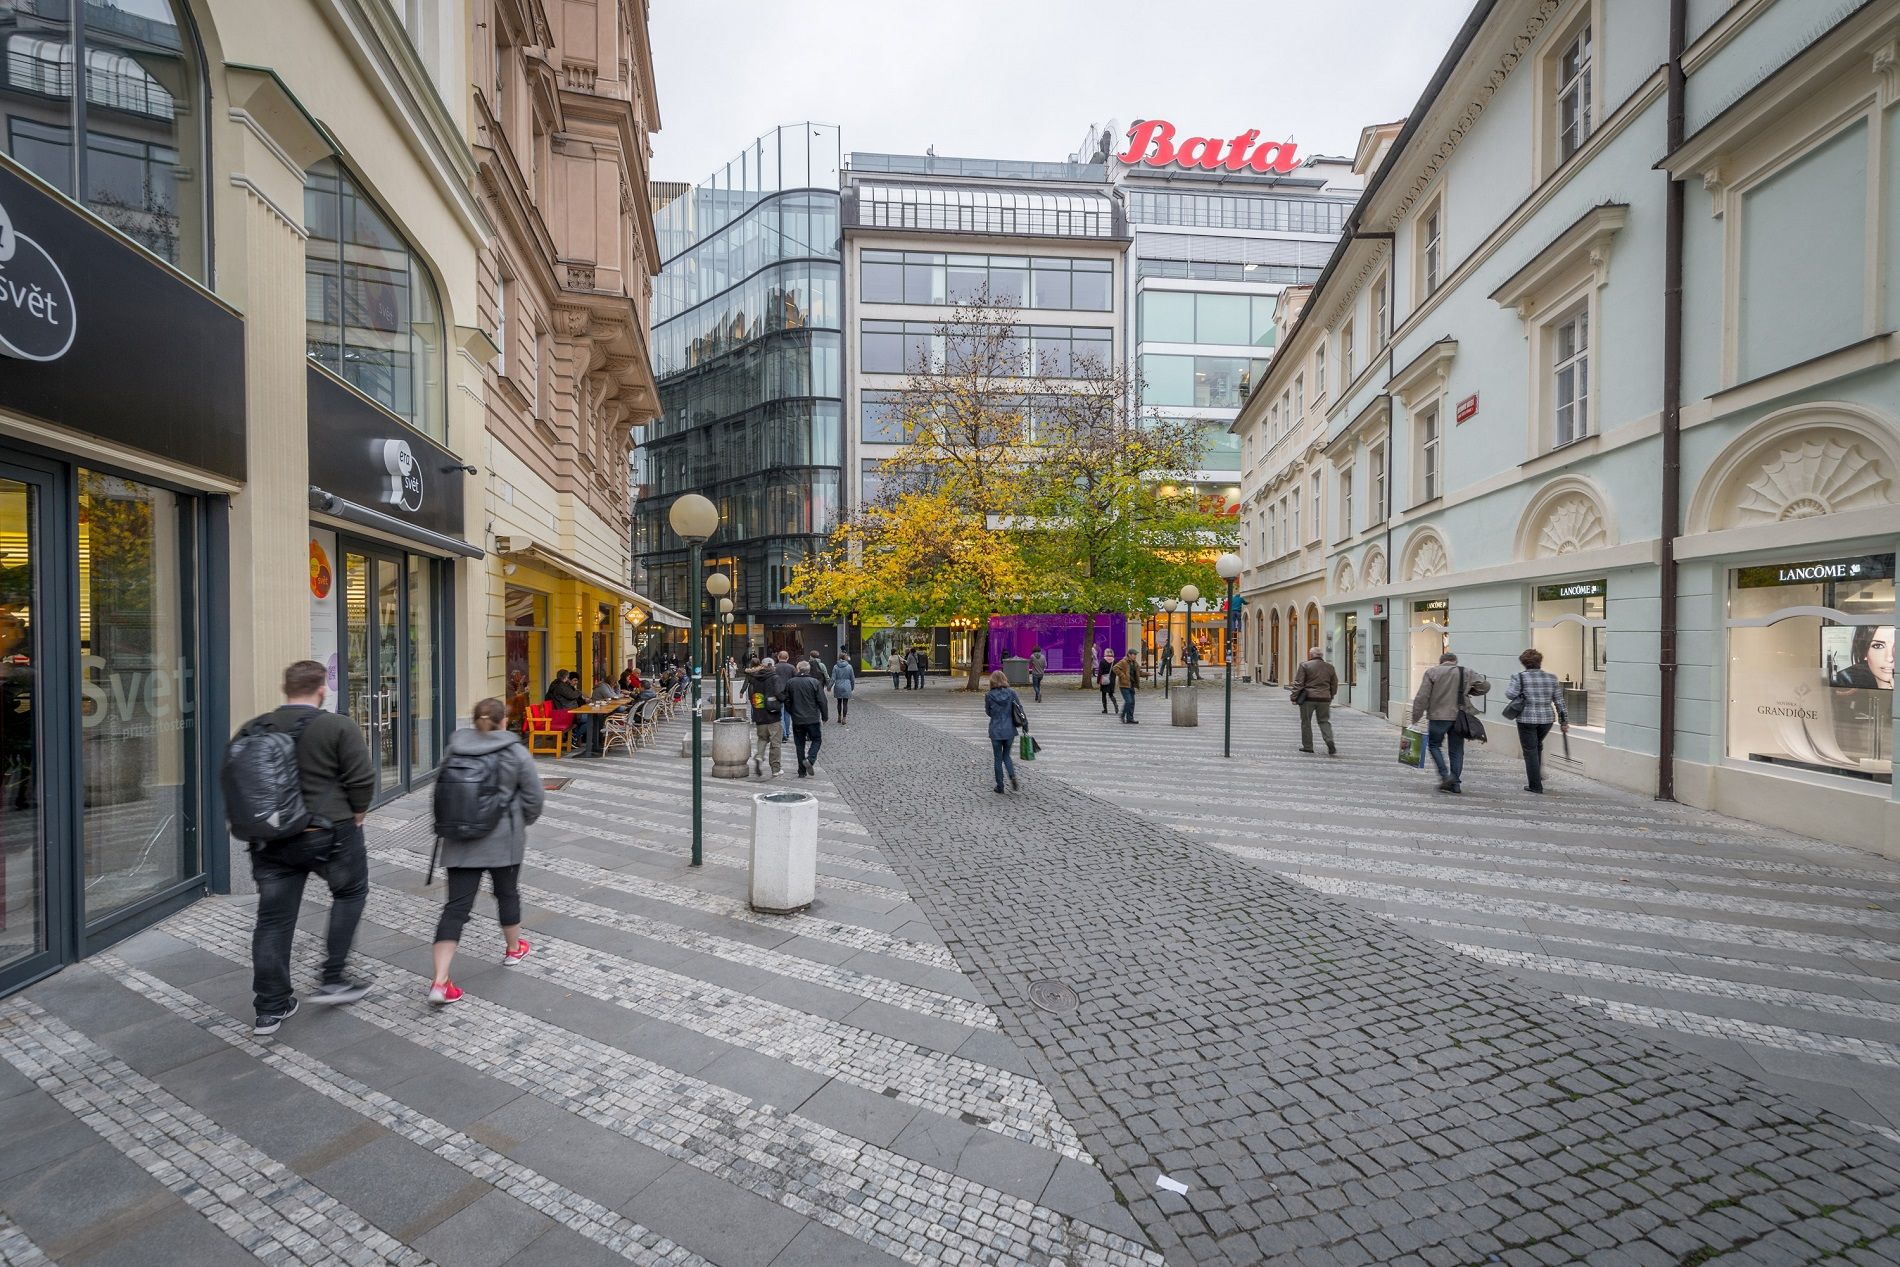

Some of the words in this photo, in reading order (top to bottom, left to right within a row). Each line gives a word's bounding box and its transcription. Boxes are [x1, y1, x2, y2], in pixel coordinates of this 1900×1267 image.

[400, 451, 410, 465] era
[405, 477, 419, 493] svět
[1779, 564, 1846, 581] LANCÔME
[317, 575, 329, 585] svět
[1560, 584, 1591, 596] LANCÔME
[1757, 705, 1818, 720] GRANDIÔSE
